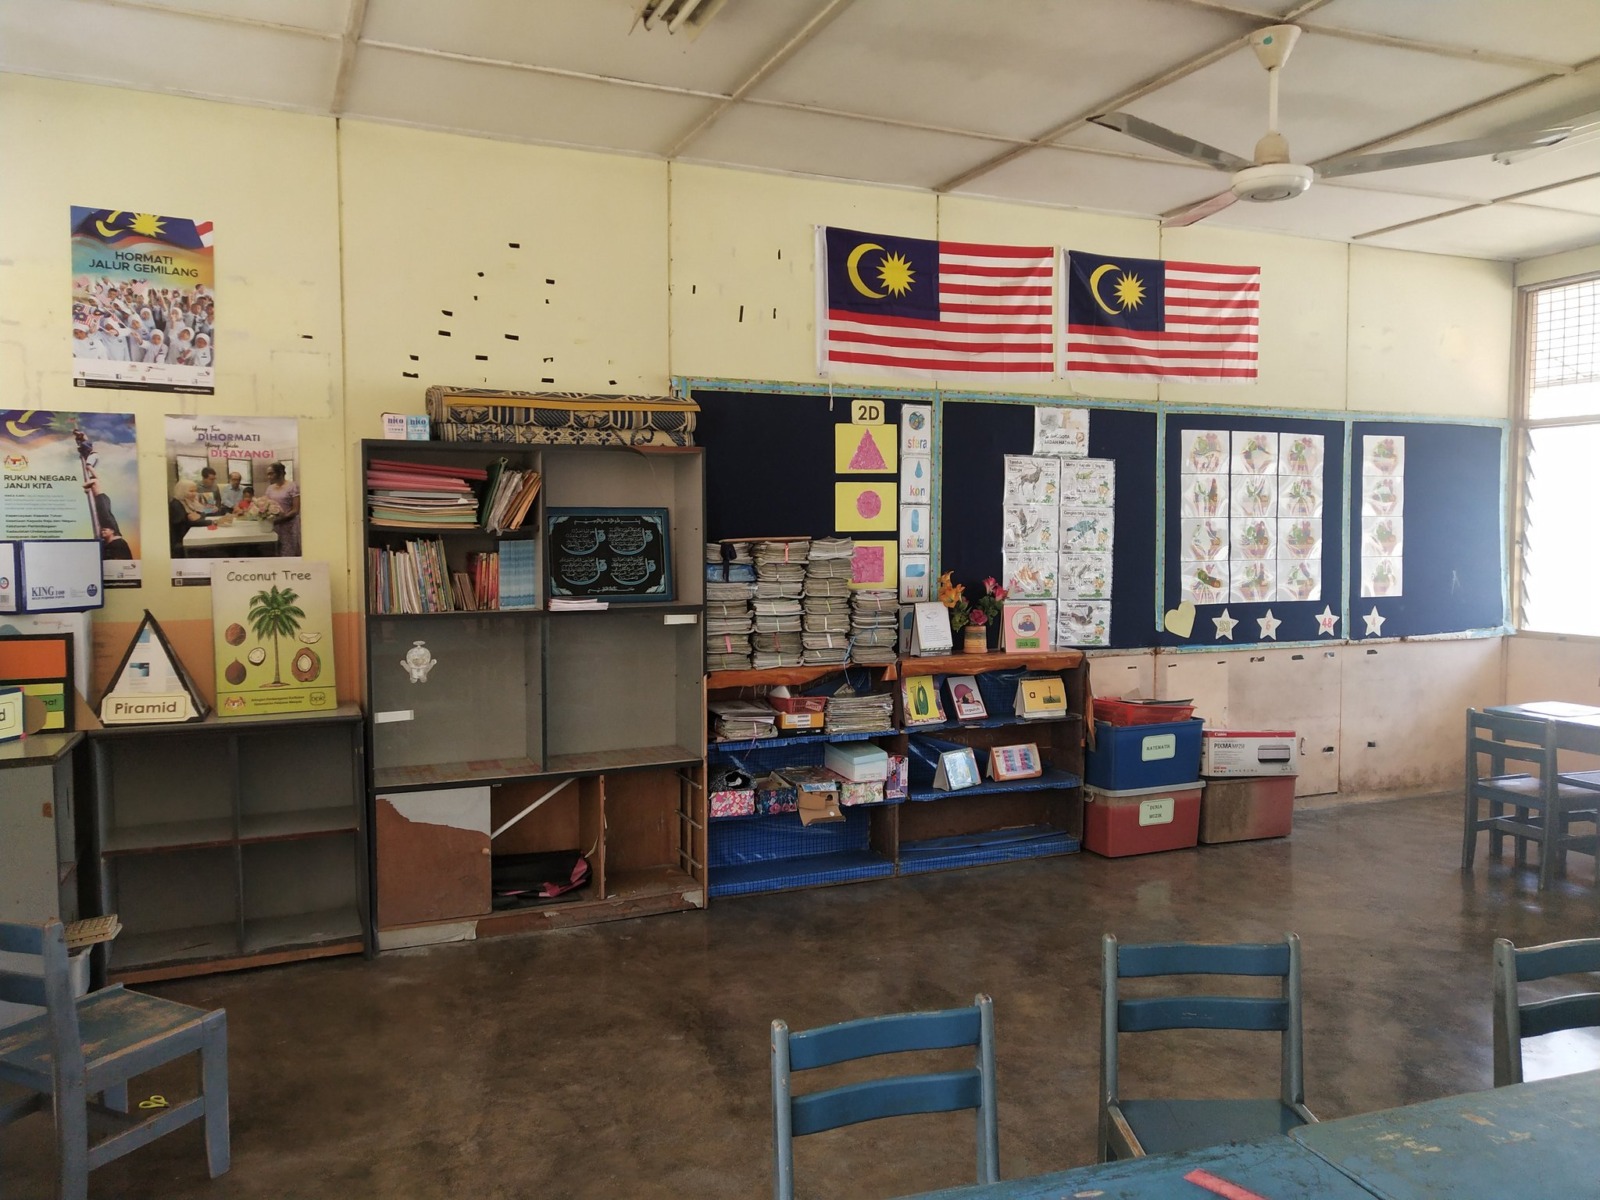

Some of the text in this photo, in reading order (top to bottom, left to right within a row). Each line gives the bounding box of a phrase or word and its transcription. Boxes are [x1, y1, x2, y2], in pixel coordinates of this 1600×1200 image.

[115, 251, 173, 265] HORMATI
[89, 259, 199, 278] JALUR GEMILANG
[858, 405, 880, 420] 2D
[198, 433, 261, 442] DIHORMATI
[907, 437, 928, 449] sfera
[211, 450, 274, 459] DISAYANGI
[4, 474, 37, 482] RUKUN
[910, 484, 926, 496] kon
[227, 570, 312, 581] Coconut Tree
[31, 586, 54, 597] KING
[1322, 617, 1332, 628] 48
[1029, 691, 1036, 699] a
[115, 702, 177, 714] Piramid
